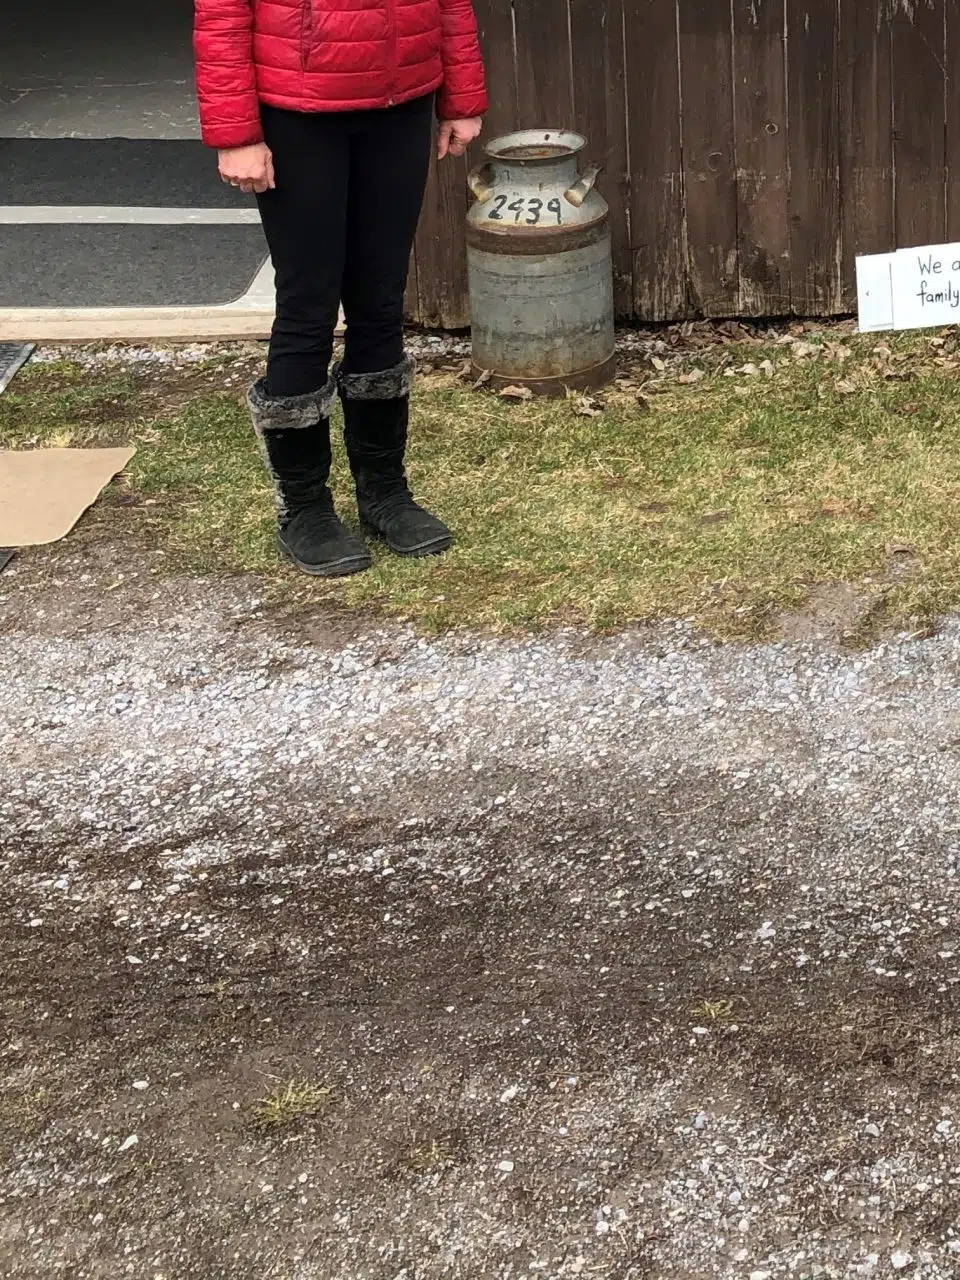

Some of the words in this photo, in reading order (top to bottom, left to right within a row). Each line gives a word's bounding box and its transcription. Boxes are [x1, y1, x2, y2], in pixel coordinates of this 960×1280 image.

[488, 194, 563, 225] 2439
[917, 254, 943, 276] We
[916, 281, 960, 308] family
